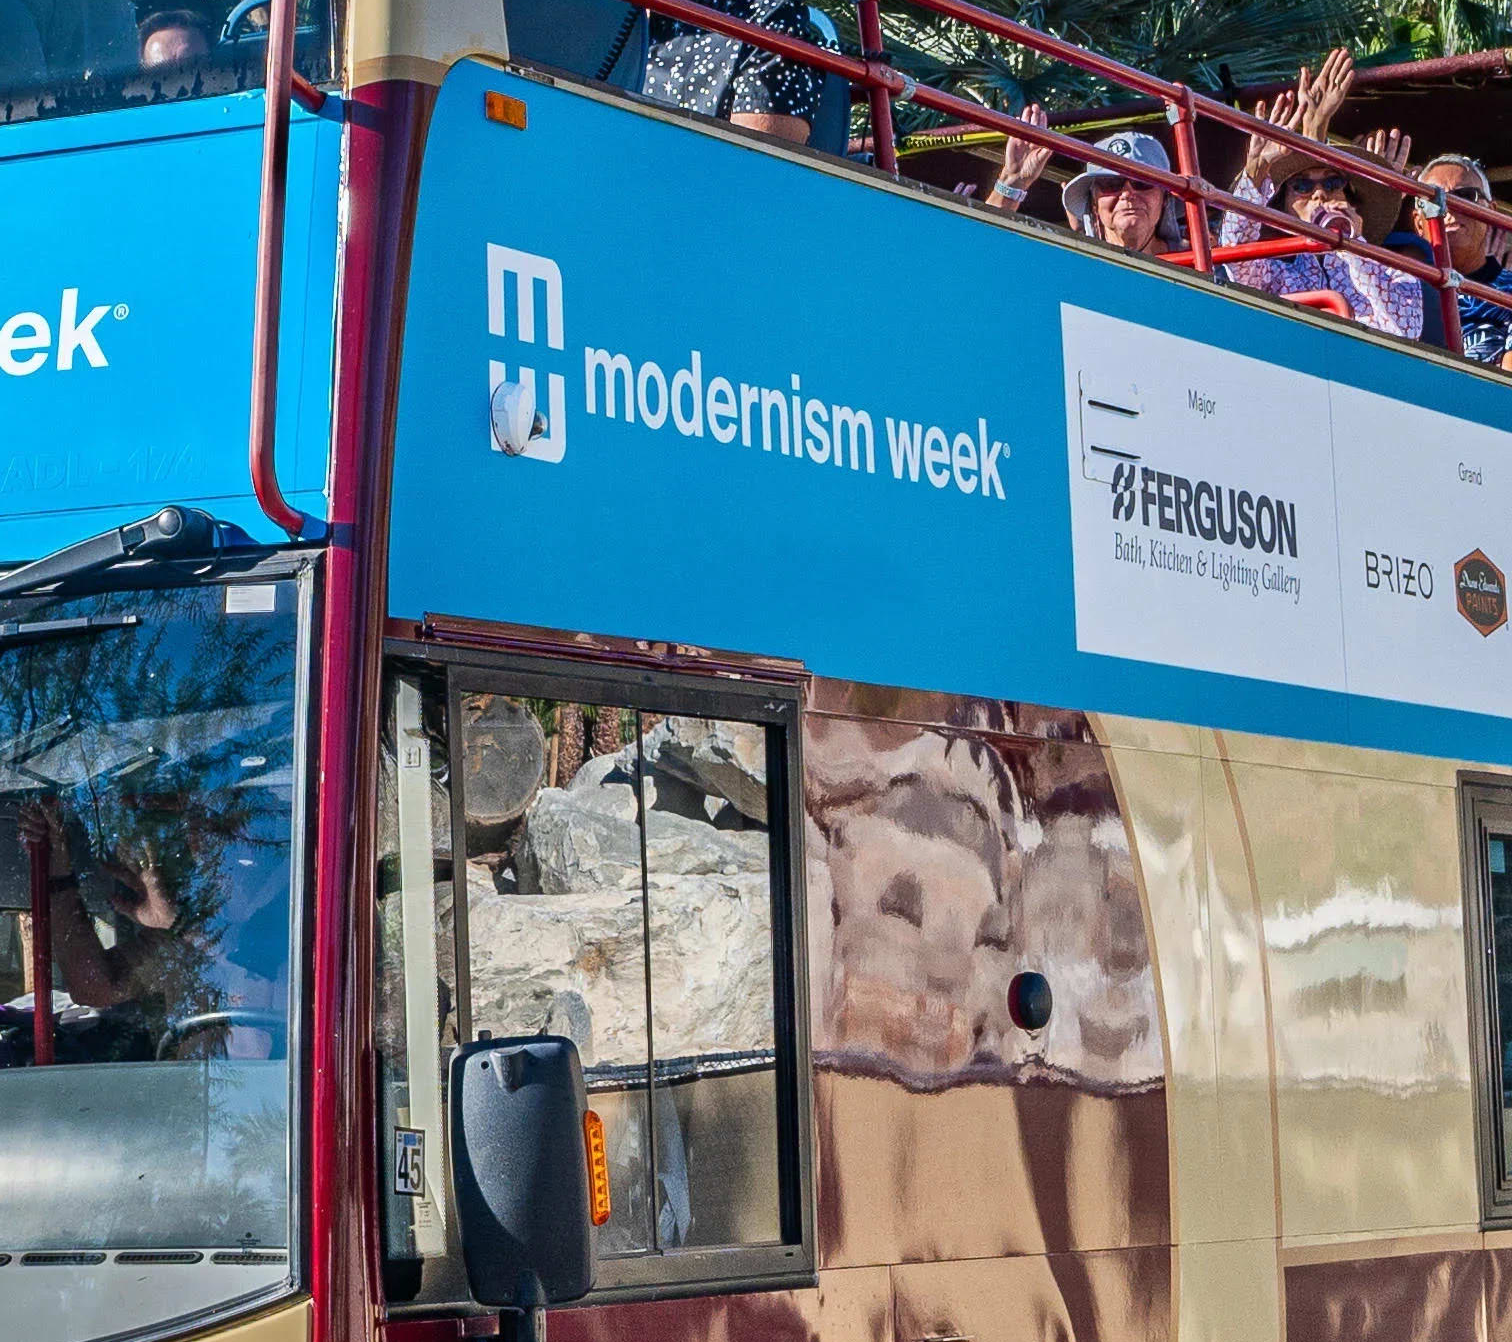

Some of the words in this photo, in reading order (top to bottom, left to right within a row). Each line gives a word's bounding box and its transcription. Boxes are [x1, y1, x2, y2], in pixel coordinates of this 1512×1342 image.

[584, 346, 875, 474] modernism
[1188, 389, 1216, 419] Major
[1458, 462, 1483, 486] Grand
[1140, 466, 1298, 558] FERGUSON
[1114, 532, 1145, 570] Bath,
[1150, 539, 1192, 575] Kitchen
[1197, 550, 1207, 576] &
[1211, 552, 1259, 597] Lighting
[1261, 563, 1300, 605] Gallery
[1364, 550, 1433, 601] BRIZO
[397, 1146, 421, 1191] 45
